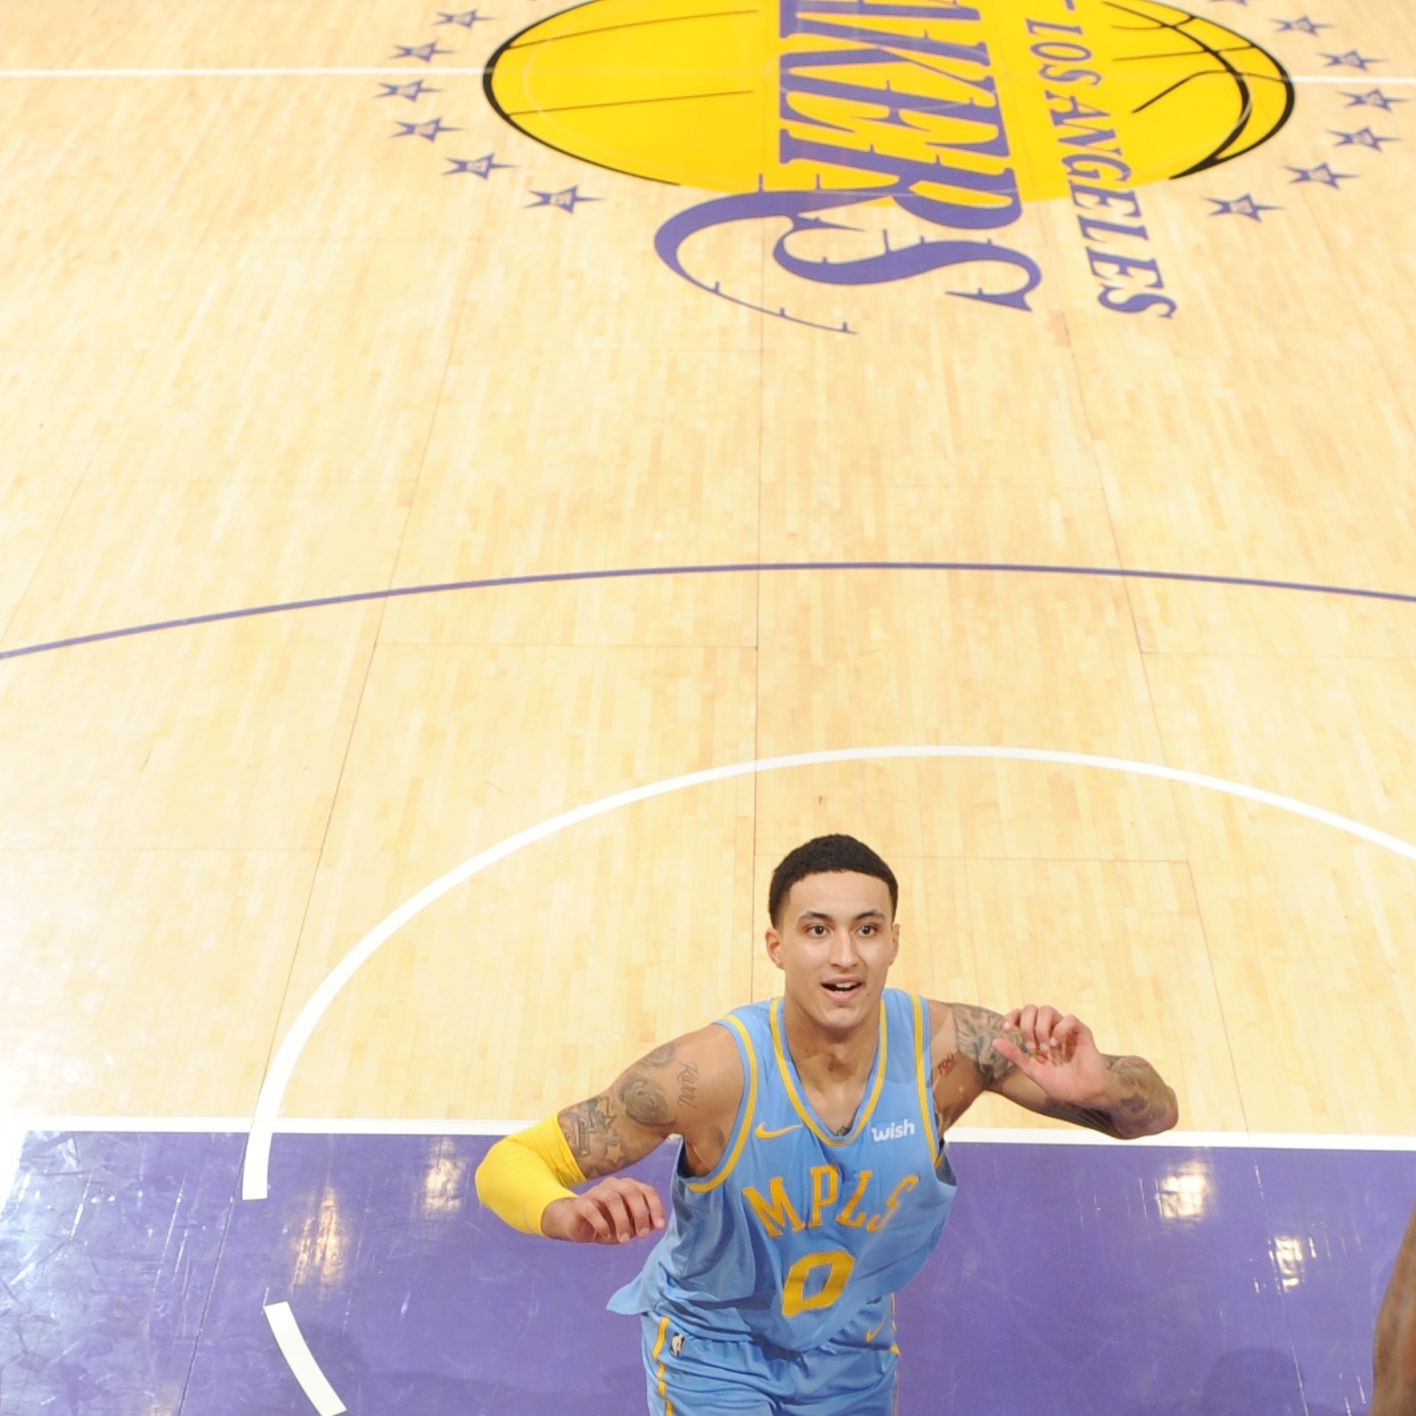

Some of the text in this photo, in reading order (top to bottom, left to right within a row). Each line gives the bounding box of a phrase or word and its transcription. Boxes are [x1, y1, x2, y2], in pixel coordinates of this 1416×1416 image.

[1025, 18, 1177, 319] LOS ANGELES
[871, 1119, 916, 1143] wish
[741, 1163, 920, 1239] MPLS
[781, 1249, 856, 1318] 0
